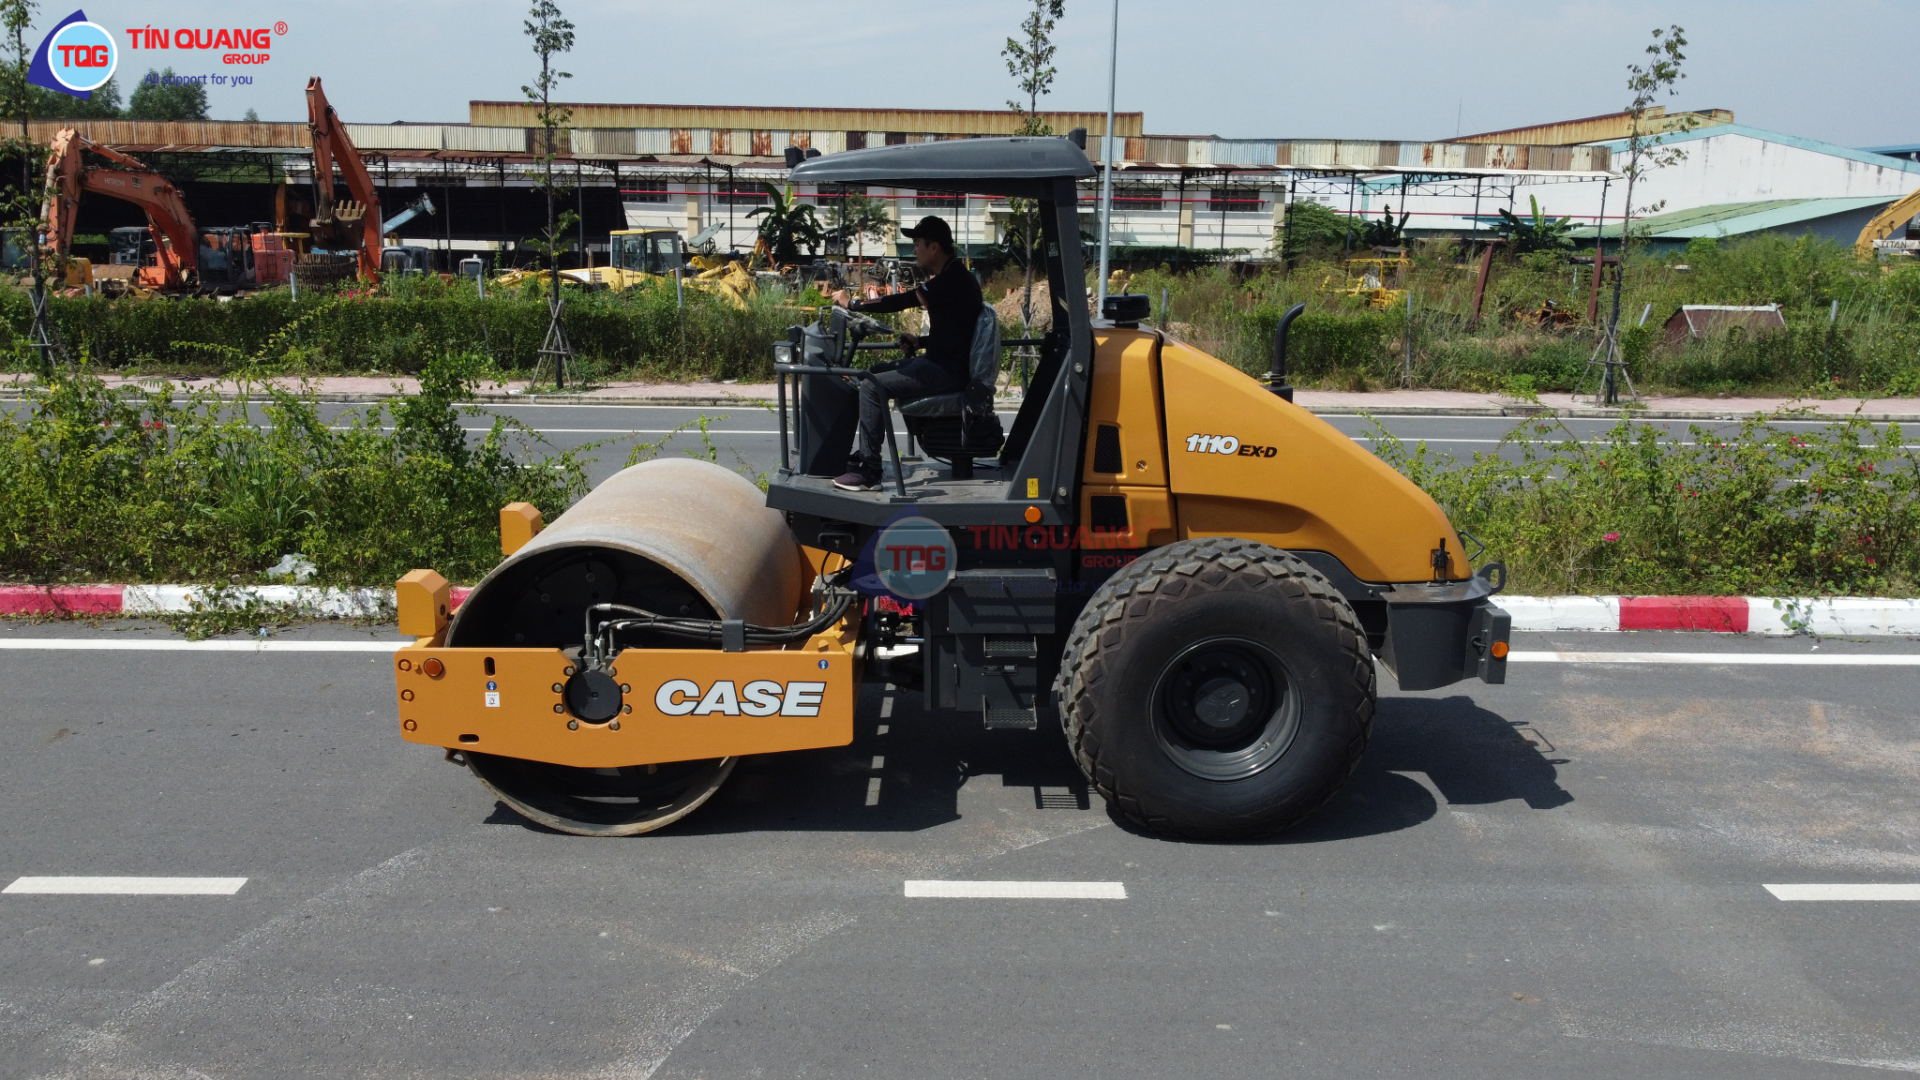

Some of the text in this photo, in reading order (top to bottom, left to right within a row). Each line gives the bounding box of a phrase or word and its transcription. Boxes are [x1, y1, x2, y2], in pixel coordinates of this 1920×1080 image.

[1881, 240, 1907, 249] TITAN
[1185, 433, 1278, 458] 1110 EX-D
[655, 678, 827, 717] CASE
